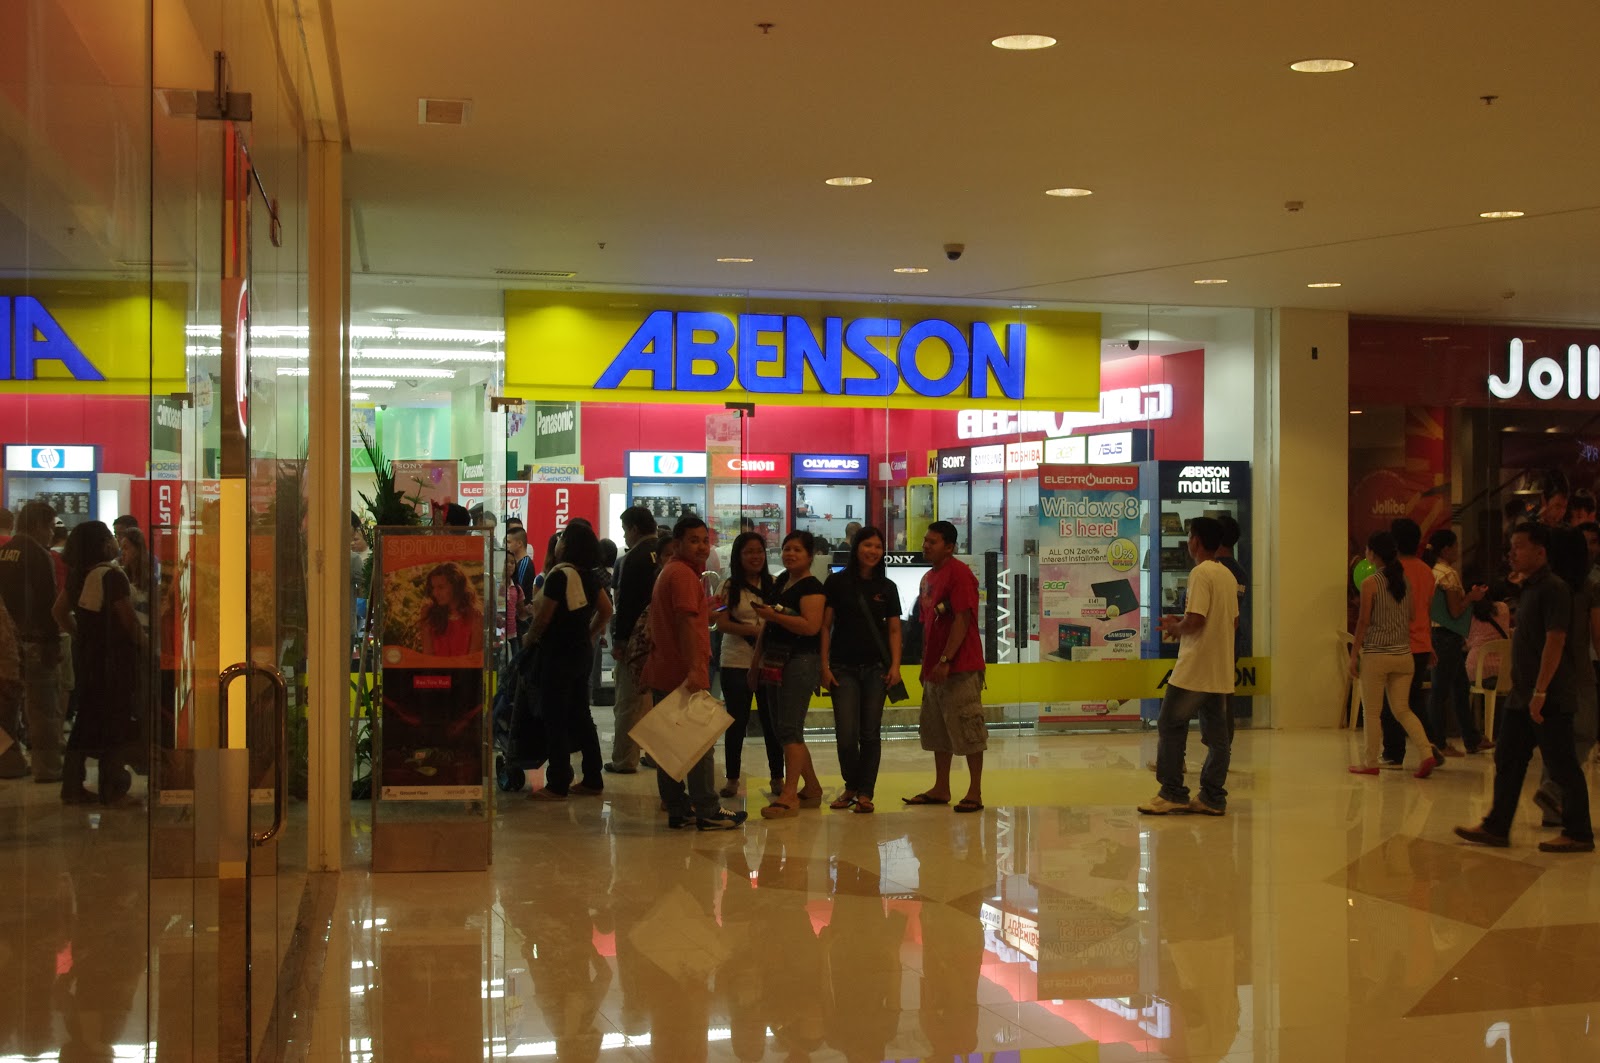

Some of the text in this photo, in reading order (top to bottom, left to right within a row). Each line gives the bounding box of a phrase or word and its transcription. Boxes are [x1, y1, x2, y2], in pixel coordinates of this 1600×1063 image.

[593, 309, 1027, 400] ABENSON
[1487, 337, 1600, 400] Joll
[536, 405, 574, 436] Panasonic
[1098, 442, 1123, 455] ASUS
[942, 455, 966, 468] SONY
[974, 453, 1002, 466] SAMSUNG
[1010, 449, 1041, 463] TOSHIBA
[537, 466, 579, 475] ABENSON
[727, 458, 775, 471] Canon
[803, 459, 860, 469] OLYMPUS
[1178, 466, 1230, 478] ABENSON
[1044, 473, 1134, 486] ELECTROWORLD
[1041, 496, 1140, 519] Windows 8
[1060, 519, 1118, 537] is here!
[387, 539, 467, 559] spruce
[1049, 548, 1062, 556] ALL
[1076, 547, 1100, 555] Zero%
[1111, 542, 1134, 559] 0%
[883, 555, 915, 564] ONY
[1042, 580, 1070, 590] acer
[997, 568, 1011, 664] RAVIA
